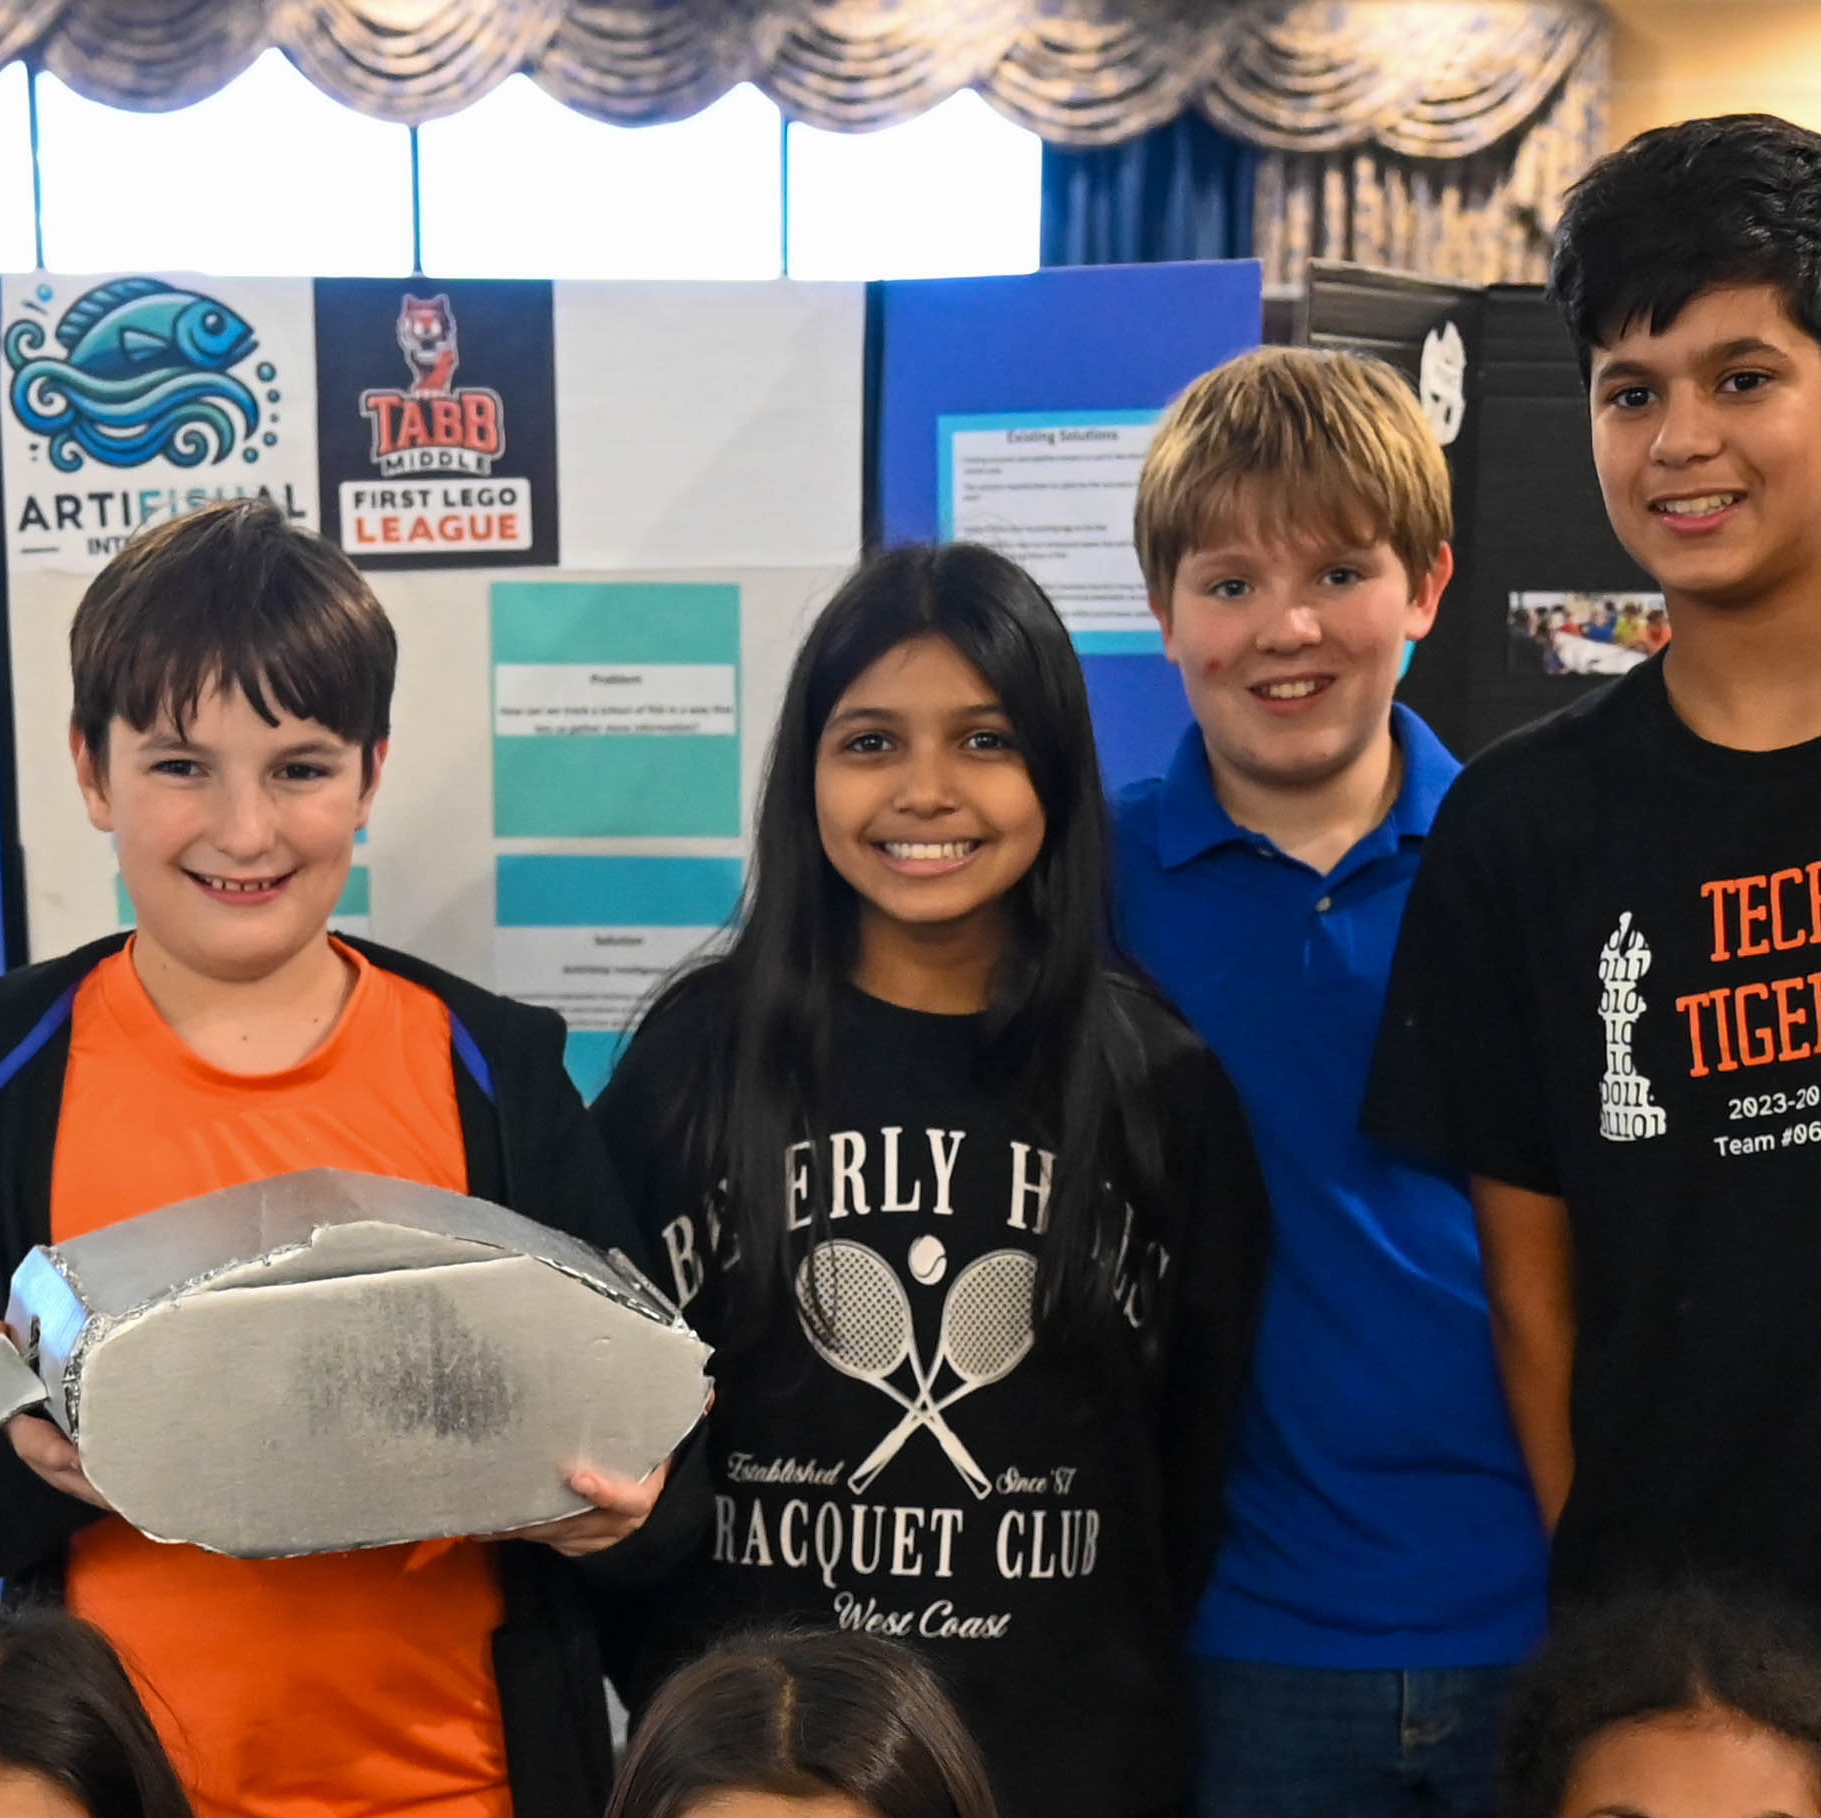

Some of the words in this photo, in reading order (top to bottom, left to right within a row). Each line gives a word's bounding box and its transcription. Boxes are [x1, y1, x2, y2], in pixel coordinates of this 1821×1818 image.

[367, 393, 499, 455] TABB
[1006, 430, 1055, 446] Existing
[1060, 429, 1119, 442] Solutions
[386, 451, 485, 471] MIDDLE
[354, 488, 431, 509] FIRST
[443, 488, 517, 508] LEGO
[356, 514, 518, 543] LEAGUE
[1714, 1134, 1775, 1157] Team
[662, 1126, 966, 1310] BERLY
[728, 1451, 845, 1487] Established
[996, 1465, 1047, 1494] Since
[713, 1494, 963, 1588] RACQUET
[996, 1508, 1100, 1579] CLUB
[834, 1590, 915, 1635] West
[919, 1599, 1013, 1640] Coast
